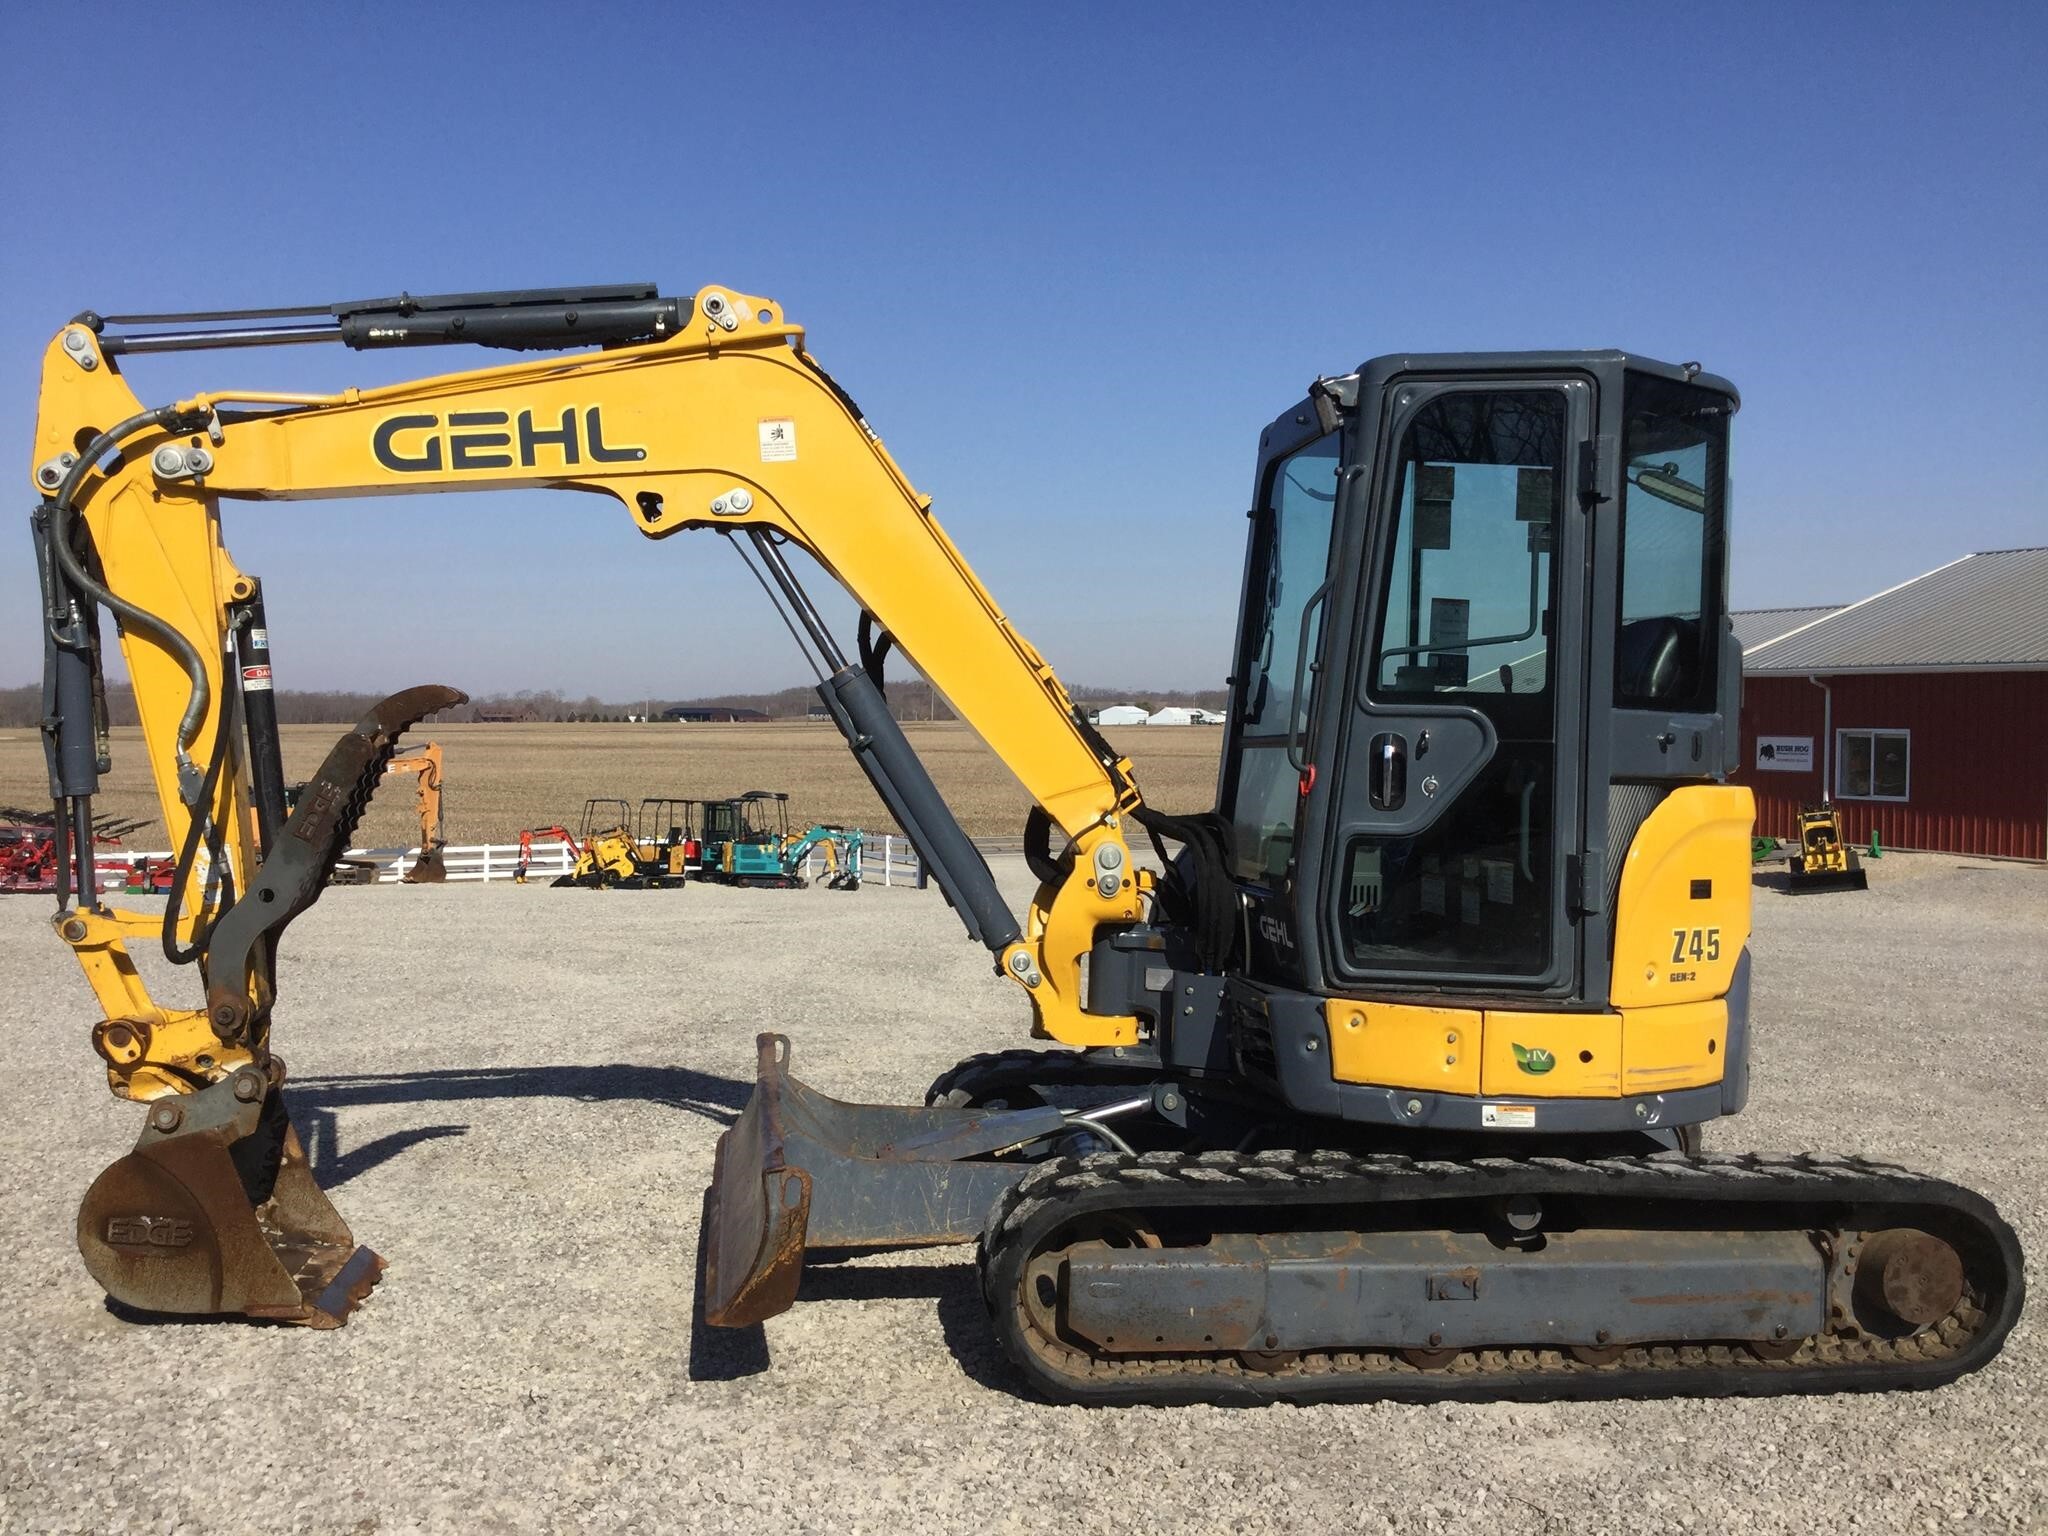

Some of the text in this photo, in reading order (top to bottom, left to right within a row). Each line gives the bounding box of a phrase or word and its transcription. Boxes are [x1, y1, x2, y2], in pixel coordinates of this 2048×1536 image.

[373, 406, 647, 472] GEHL
[1260, 915, 1294, 949] GEHL
[1672, 929, 1720, 964] Z45
[108, 1217, 192, 1248] EDGE
